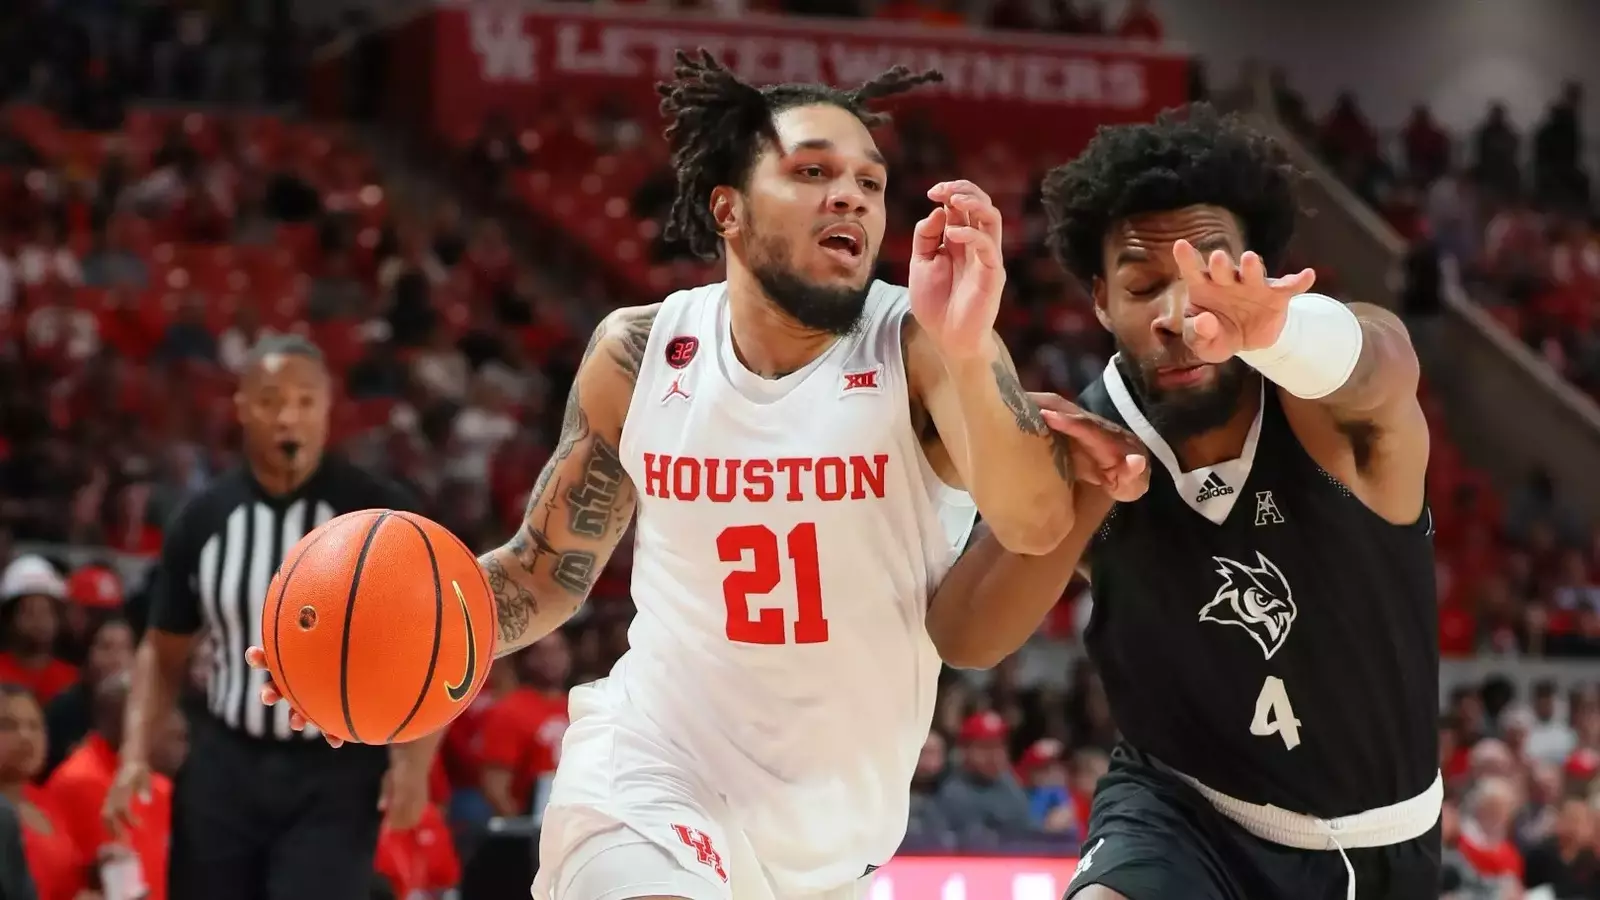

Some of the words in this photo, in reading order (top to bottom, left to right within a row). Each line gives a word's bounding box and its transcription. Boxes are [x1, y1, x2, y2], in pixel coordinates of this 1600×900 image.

[670, 342, 694, 360] 32
[843, 371, 878, 391] XII
[643, 452, 889, 502] HOUSTON
[1195, 486, 1235, 503] adidas
[715, 522, 829, 645] 21
[1249, 675, 1301, 751] 4
